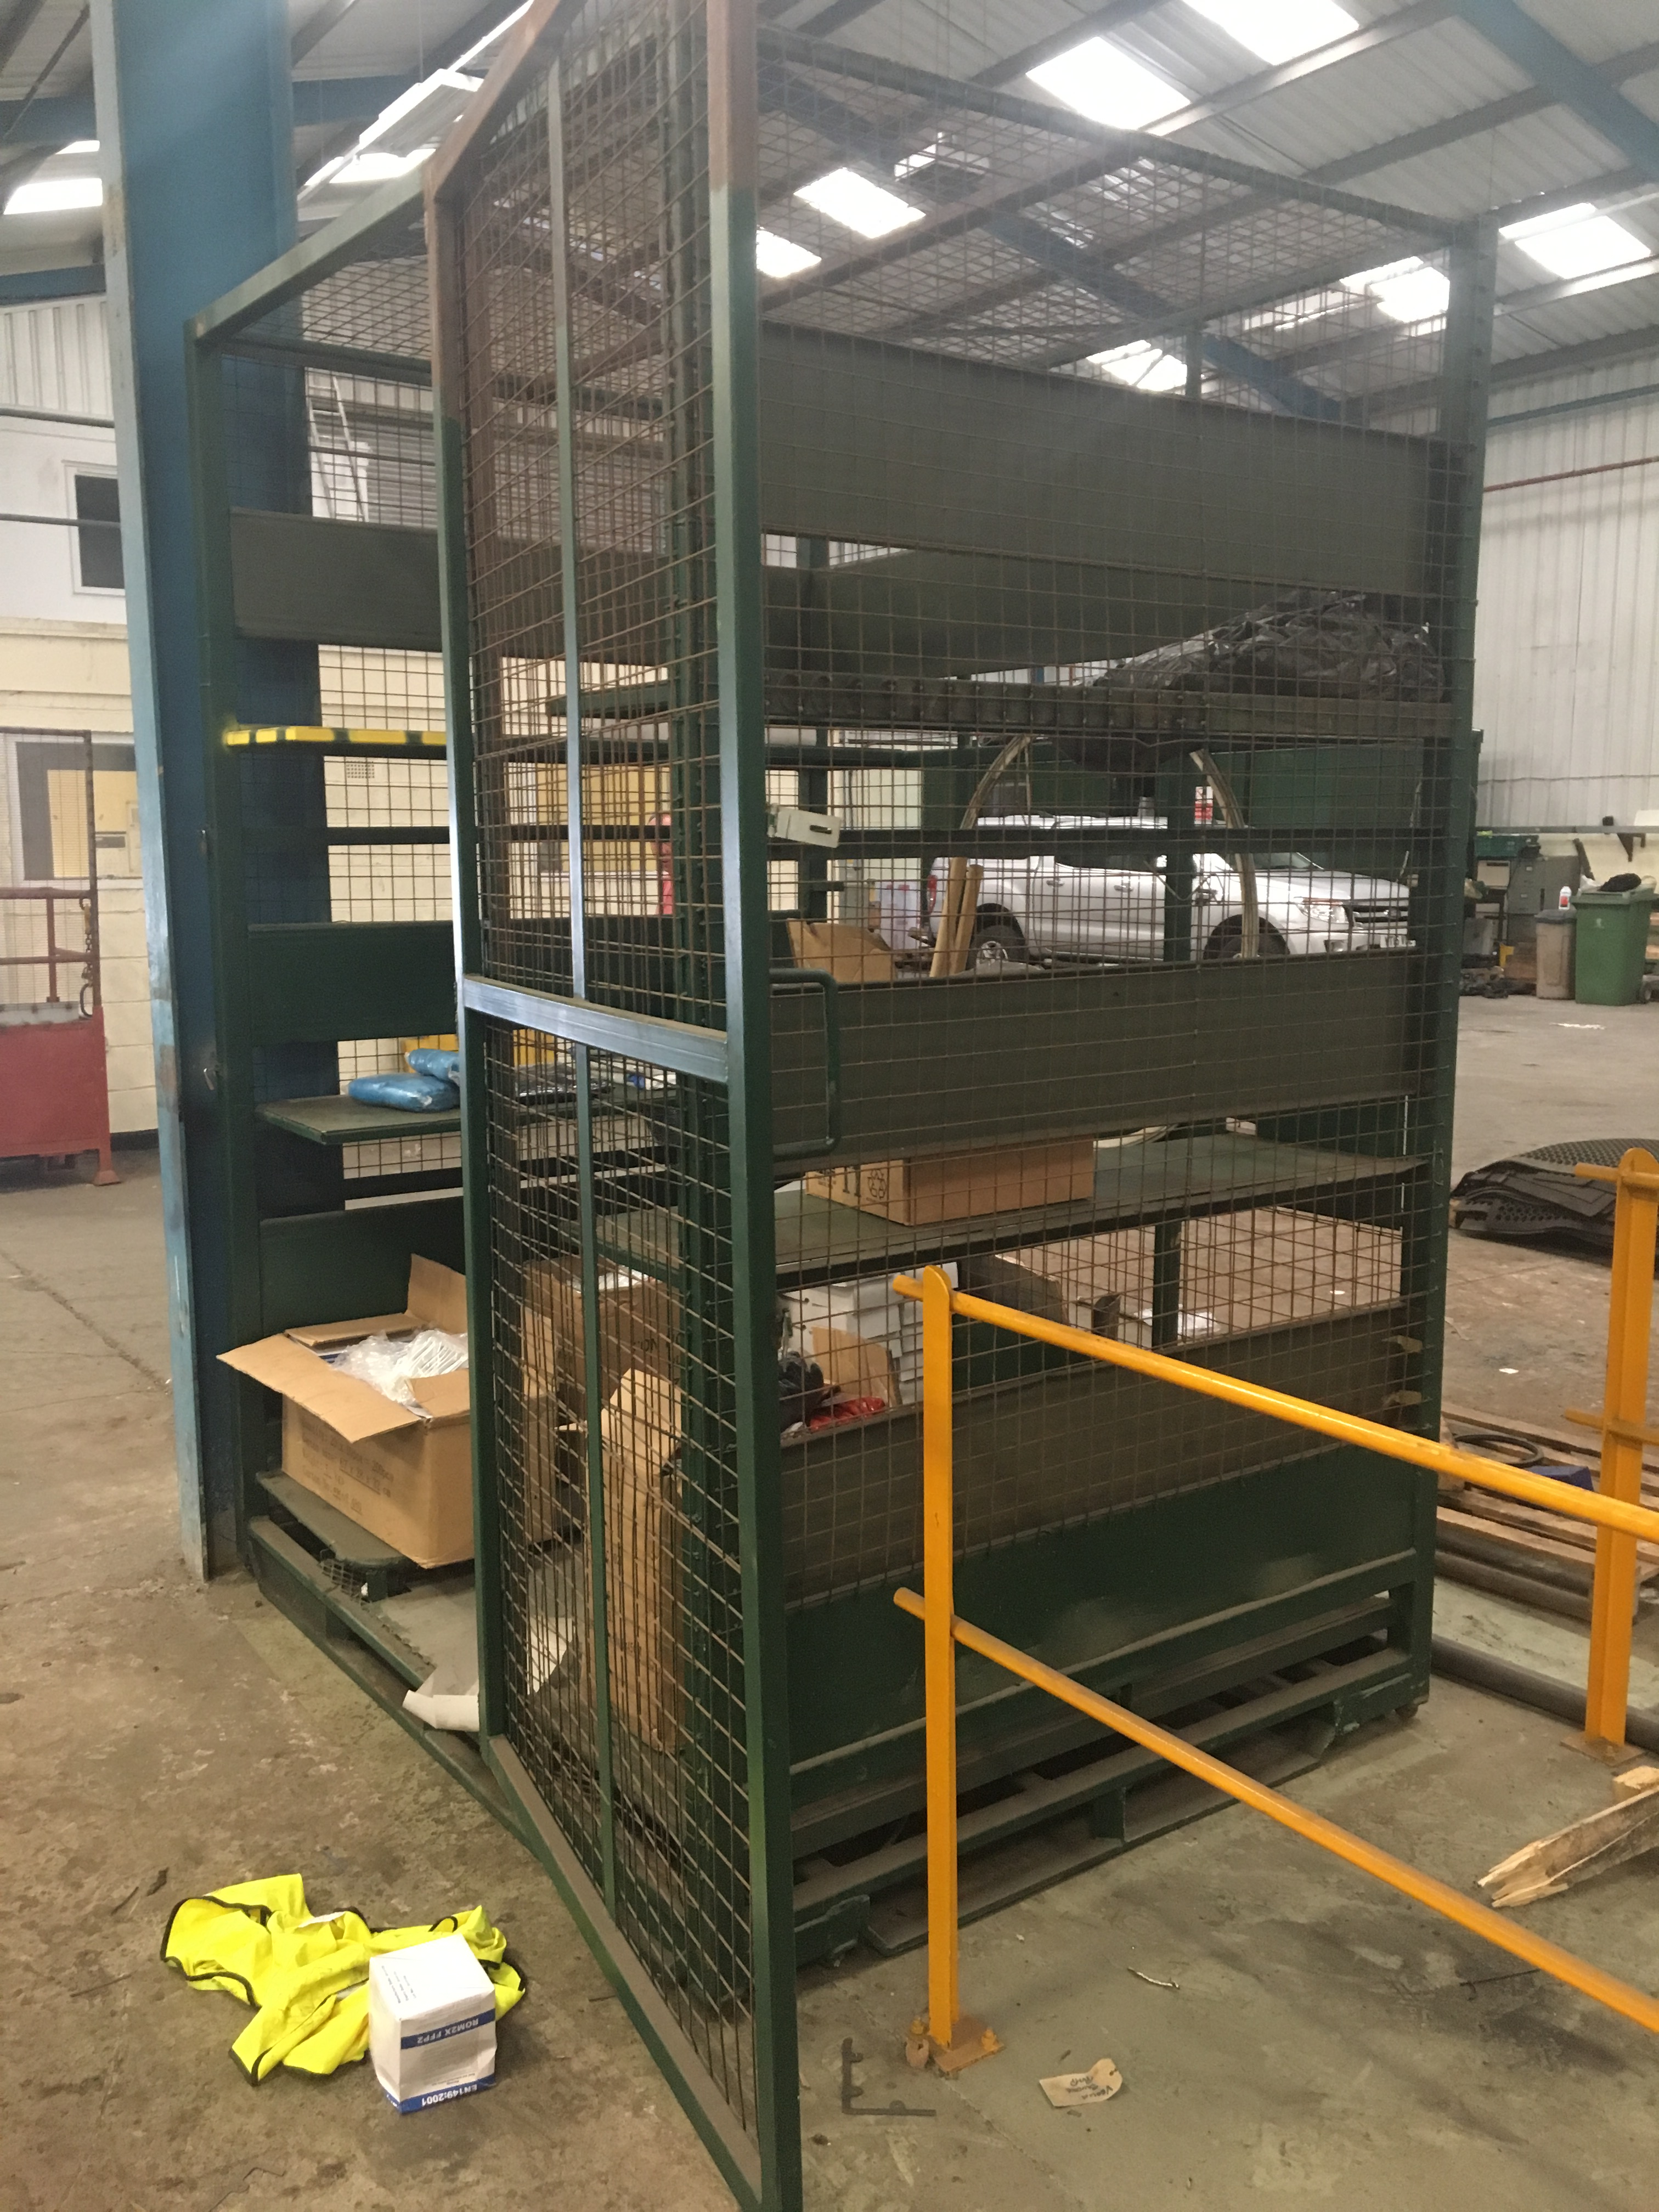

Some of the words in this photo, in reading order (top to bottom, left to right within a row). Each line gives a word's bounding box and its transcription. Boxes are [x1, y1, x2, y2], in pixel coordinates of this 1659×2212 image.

[444, 2018, 479, 2036] ROM2X
[416, 2030, 442, 2044] FFP2
[421, 2084, 477, 2107] EN149:2001
